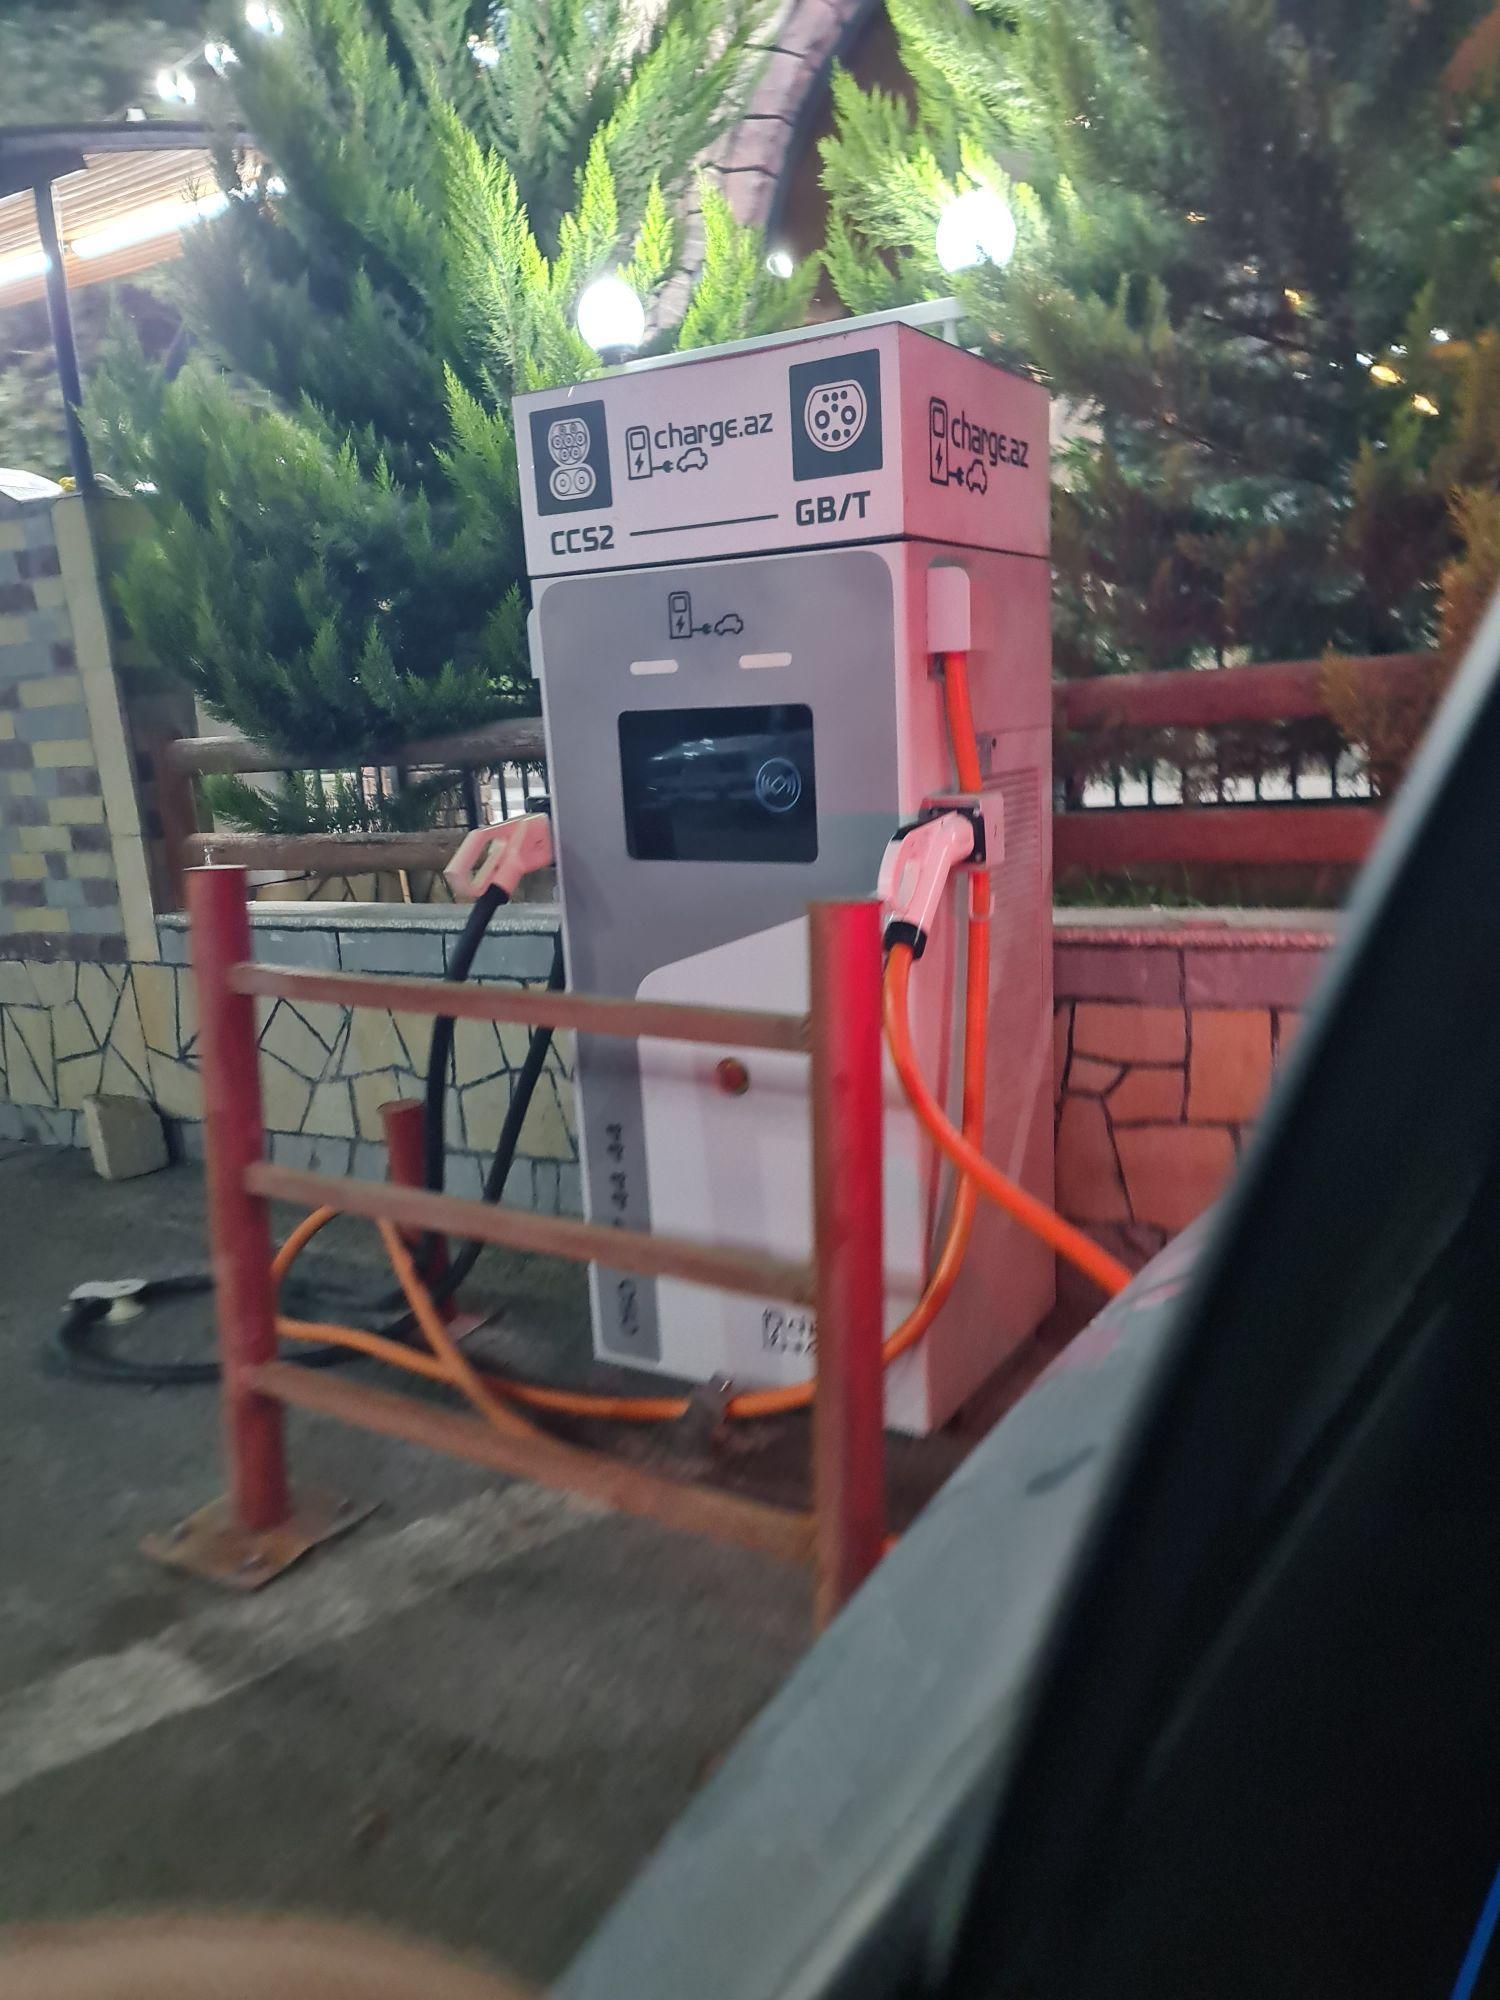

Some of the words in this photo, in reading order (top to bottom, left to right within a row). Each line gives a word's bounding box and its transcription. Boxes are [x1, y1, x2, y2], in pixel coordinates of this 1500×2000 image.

[655, 413, 773, 449] charge.az
[796, 490, 871, 526] GB/T
[550, 525, 615, 555] CCS2
